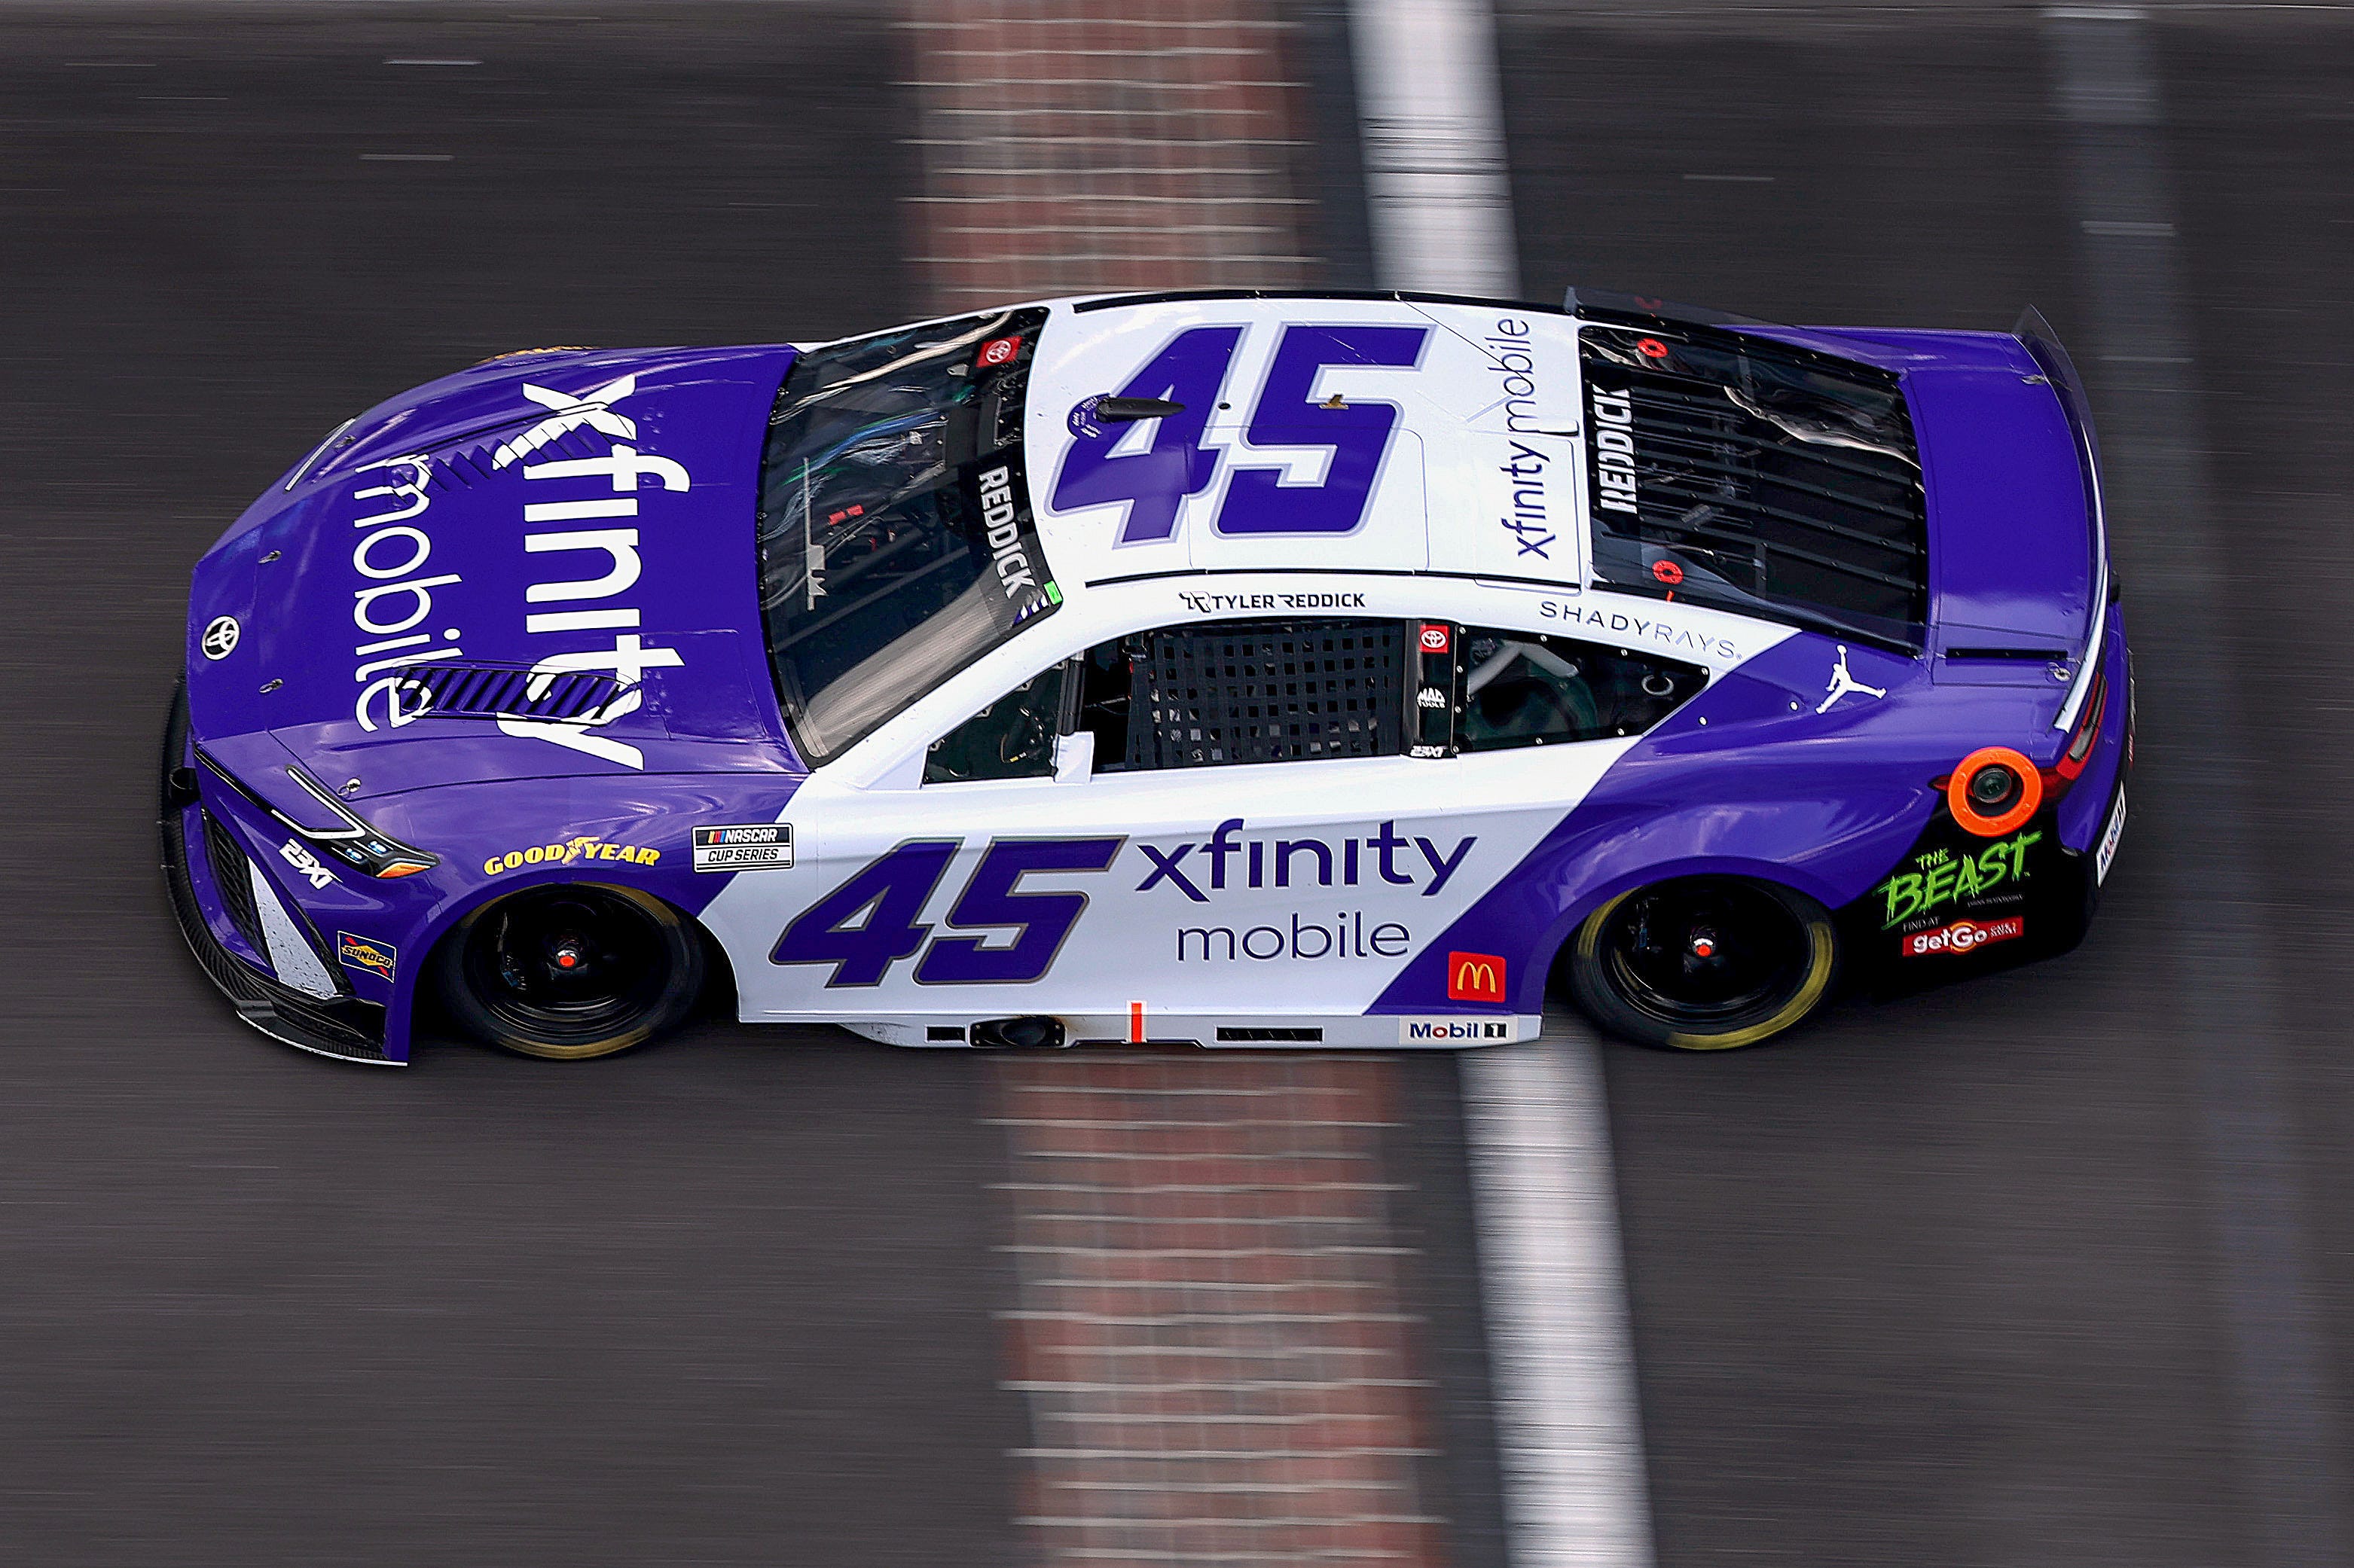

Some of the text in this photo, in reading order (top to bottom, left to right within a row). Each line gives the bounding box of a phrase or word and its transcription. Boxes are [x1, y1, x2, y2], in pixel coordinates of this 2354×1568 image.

[1050, 322, 1438, 550] 45
[1483, 318, 1556, 560] xfinity mobile
[1591, 383, 1638, 514] REDDICK
[492, 375, 691, 771] xfinity
[979, 465, 1037, 599] REDDICK
[353, 452, 463, 734] mobile
[1211, 593, 1366, 610] TYLER REDDICK
[708, 847, 779, 862] CUP SERIES
[725, 828, 777, 843] NASCAR
[1134, 818, 1479, 903] xfinity
[1915, 847, 1949, 870] THE
[768, 834, 1130, 989] 45
[1871, 831, 2043, 931] BEAST
[344, 947, 391, 968] SUNOCO
[1177, 910, 1411, 962] mobile
[1913, 926, 1988, 953] getGo
[1410, 1022, 1479, 1039] Mobil
